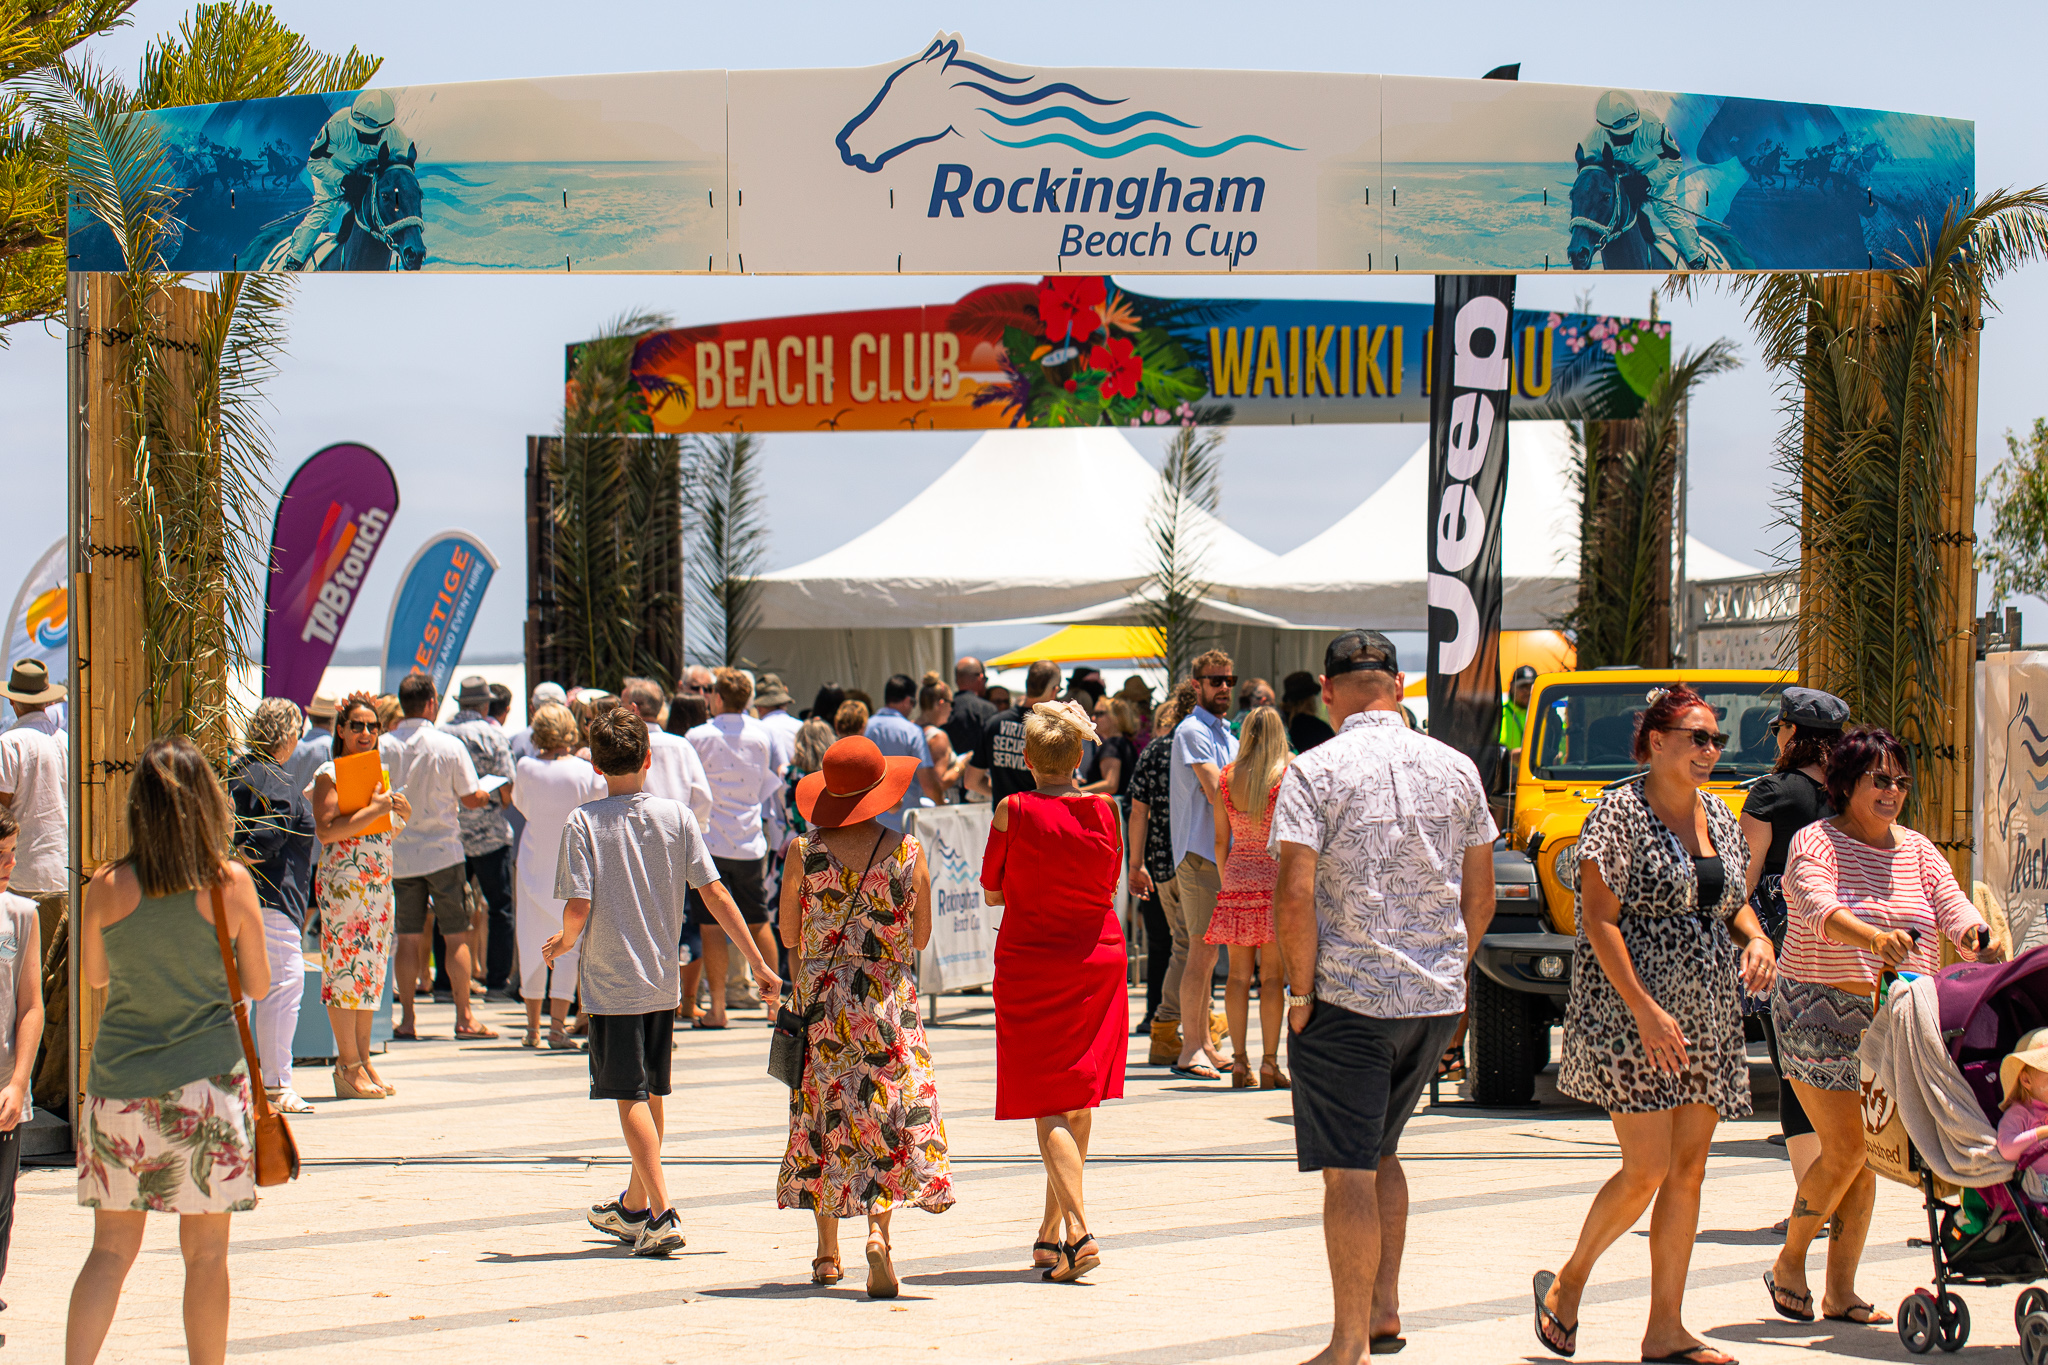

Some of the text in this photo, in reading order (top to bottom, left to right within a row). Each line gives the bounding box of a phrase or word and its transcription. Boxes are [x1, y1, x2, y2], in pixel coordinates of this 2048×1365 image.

[927, 163, 1266, 220] Rockingham
[1059, 222, 1258, 267] Beach Cup
[695, 332, 960, 409] BEACH CLUB
[1208, 325, 1404, 397] WAIKIKI
[1427, 295, 1509, 675] Jeep
[301, 506, 389, 645] TABtouch
[993, 734, 1027, 754] SECUR
